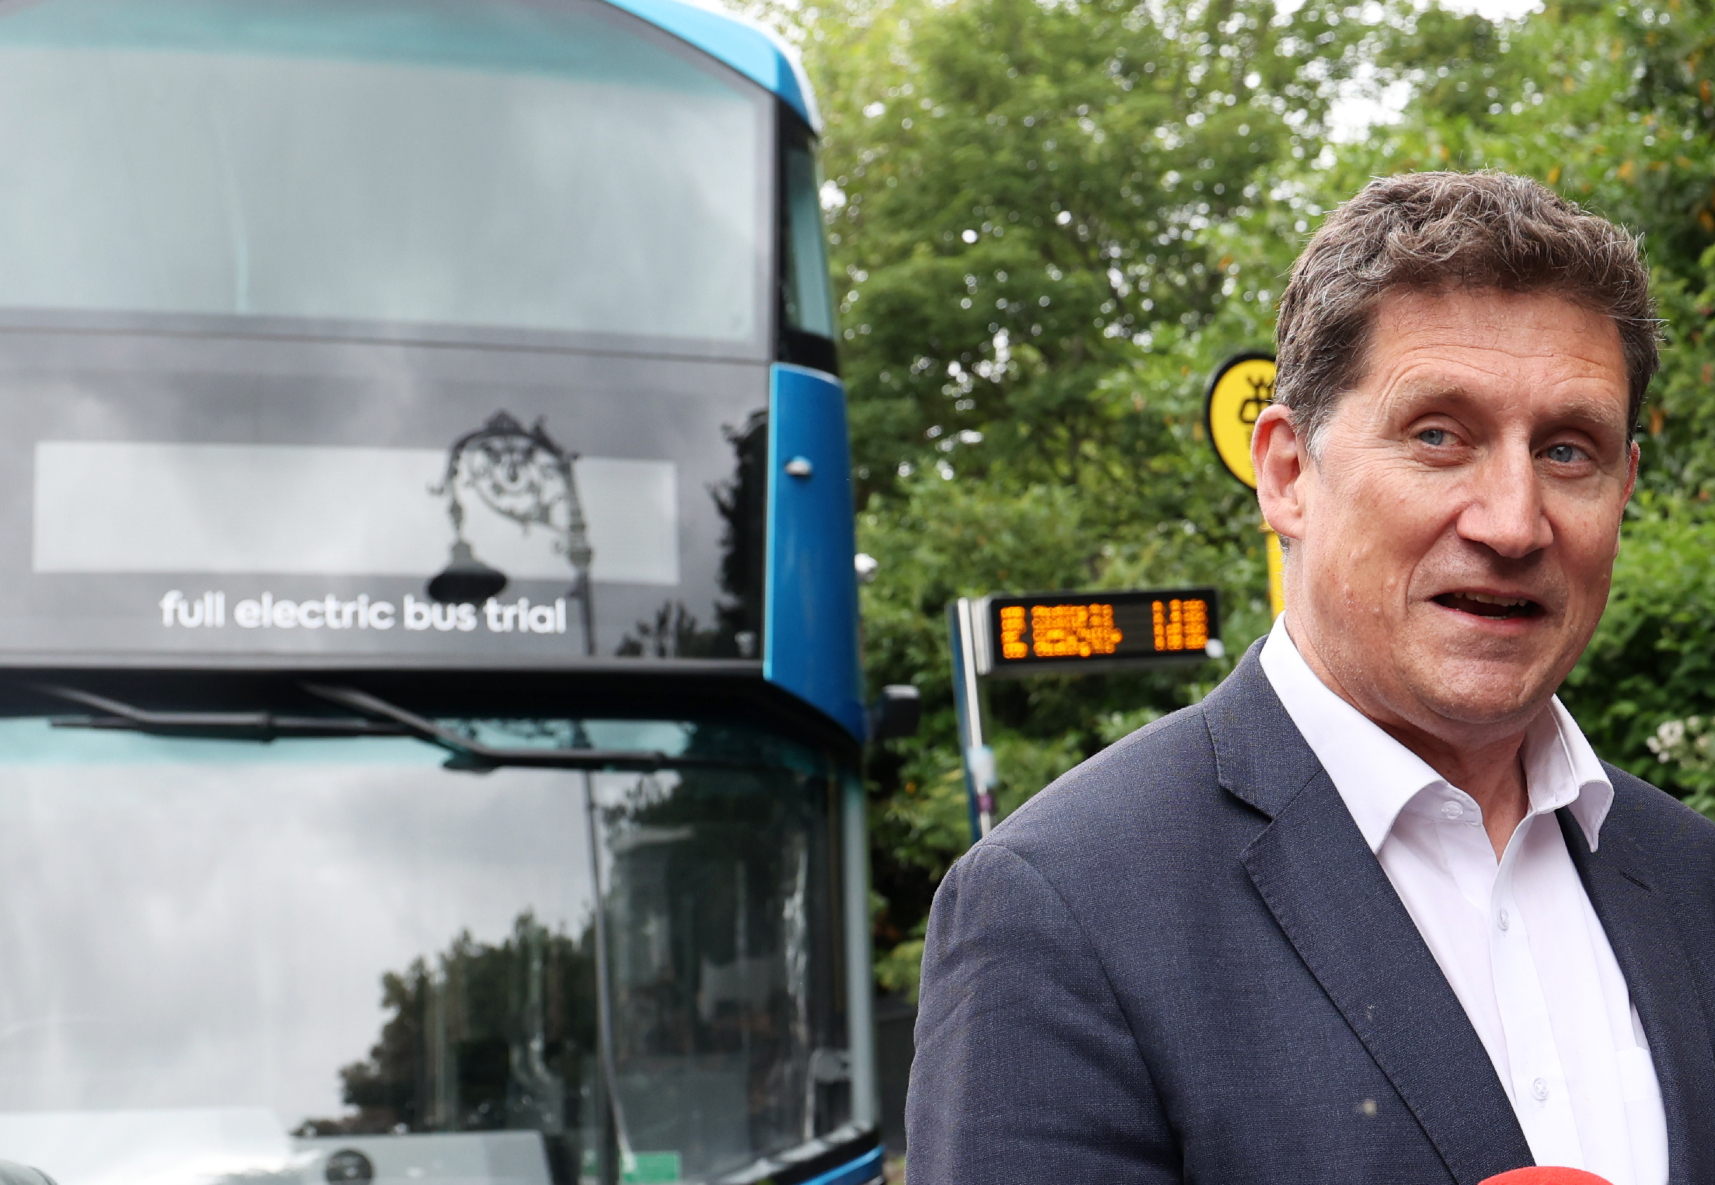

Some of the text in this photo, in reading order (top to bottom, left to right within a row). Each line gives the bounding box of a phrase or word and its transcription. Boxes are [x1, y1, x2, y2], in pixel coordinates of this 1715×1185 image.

[161, 590, 567, 634] full electric bus trial
